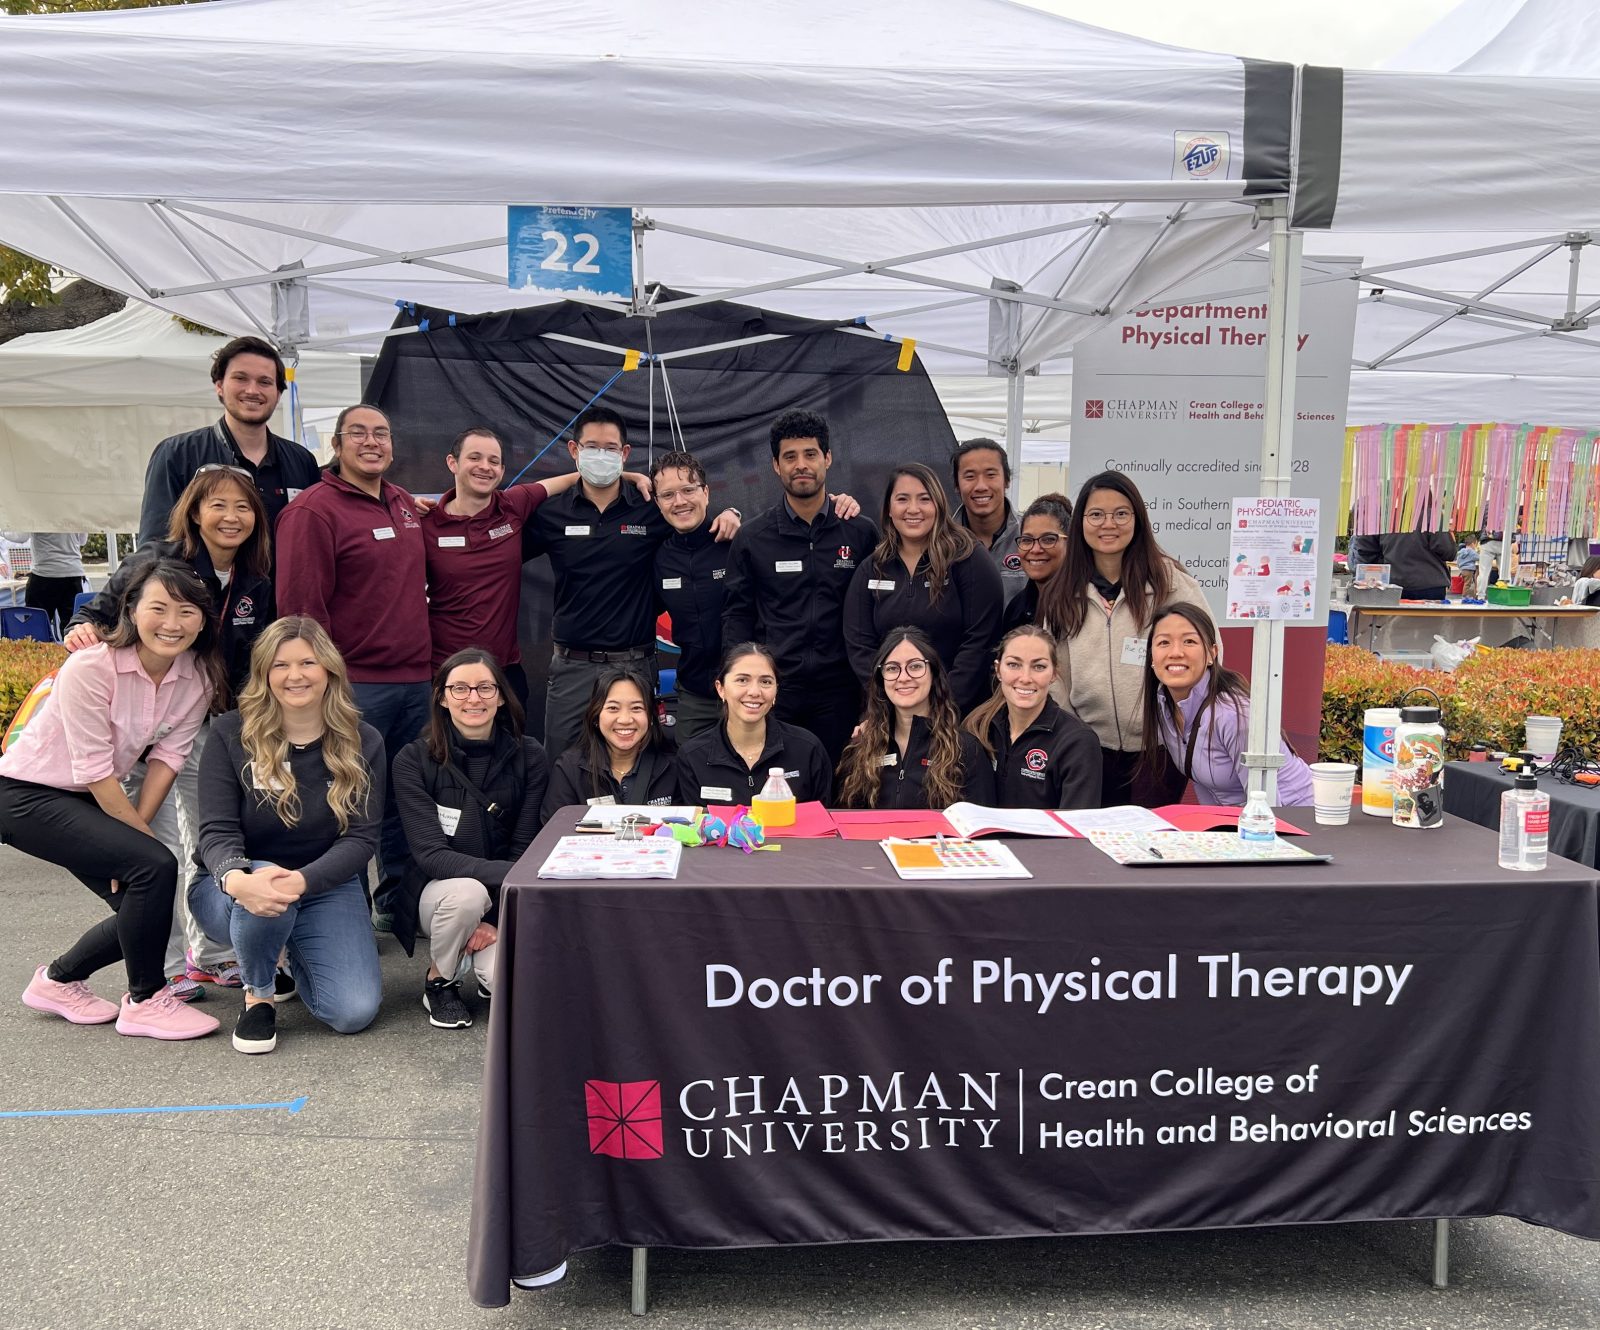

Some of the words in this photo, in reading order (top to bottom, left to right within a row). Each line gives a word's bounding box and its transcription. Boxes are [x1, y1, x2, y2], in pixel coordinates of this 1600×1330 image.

[541, 231, 600, 273] 22
[1122, 325, 1210, 349] Physical
[1219, 326, 1309, 351] Thery
[1107, 400, 1178, 410] CHAPMAN
[1189, 400, 1217, 409] Crean
[1220, 400, 1254, 410] College
[1107, 410, 1178, 420] UNIVERSITY
[1189, 411, 1220, 419] Health
[1223, 411, 1241, 419] and
[1297, 412, 1335, 421] Sciences
[1105, 458, 1172, 476] Continually
[1177, 458, 1239, 472] accredited
[1162, 498, 1173, 510] in
[1178, 497, 1230, 510] Southern
[1257, 499, 1301, 508] PEDIATRIC
[1237, 508, 1281, 516] PHYSICAL
[1284, 508, 1317, 517] THERAPY
[1165, 517, 1212, 530] medical
[1185, 555, 1229, 568] educati
[706, 964, 882, 1009] Doctor
[900, 957, 953, 1005] of
[973, 953, 1177, 1014] Physical
[1198, 952, 1414, 1006] Therapy
[1039, 1072, 1137, 1100] Crean
[1150, 1067, 1274, 1100] College
[1286, 1064, 1319, 1093] of
[679, 1071, 1001, 1121] CHAPMAN
[1039, 1118, 1144, 1149] Health
[1156, 1115, 1216, 1144] and
[1229, 1110, 1396, 1143] Behavioral
[1407, 1107, 1532, 1136] Sciences
[681, 1116, 1001, 1159] UNIVERSITY
